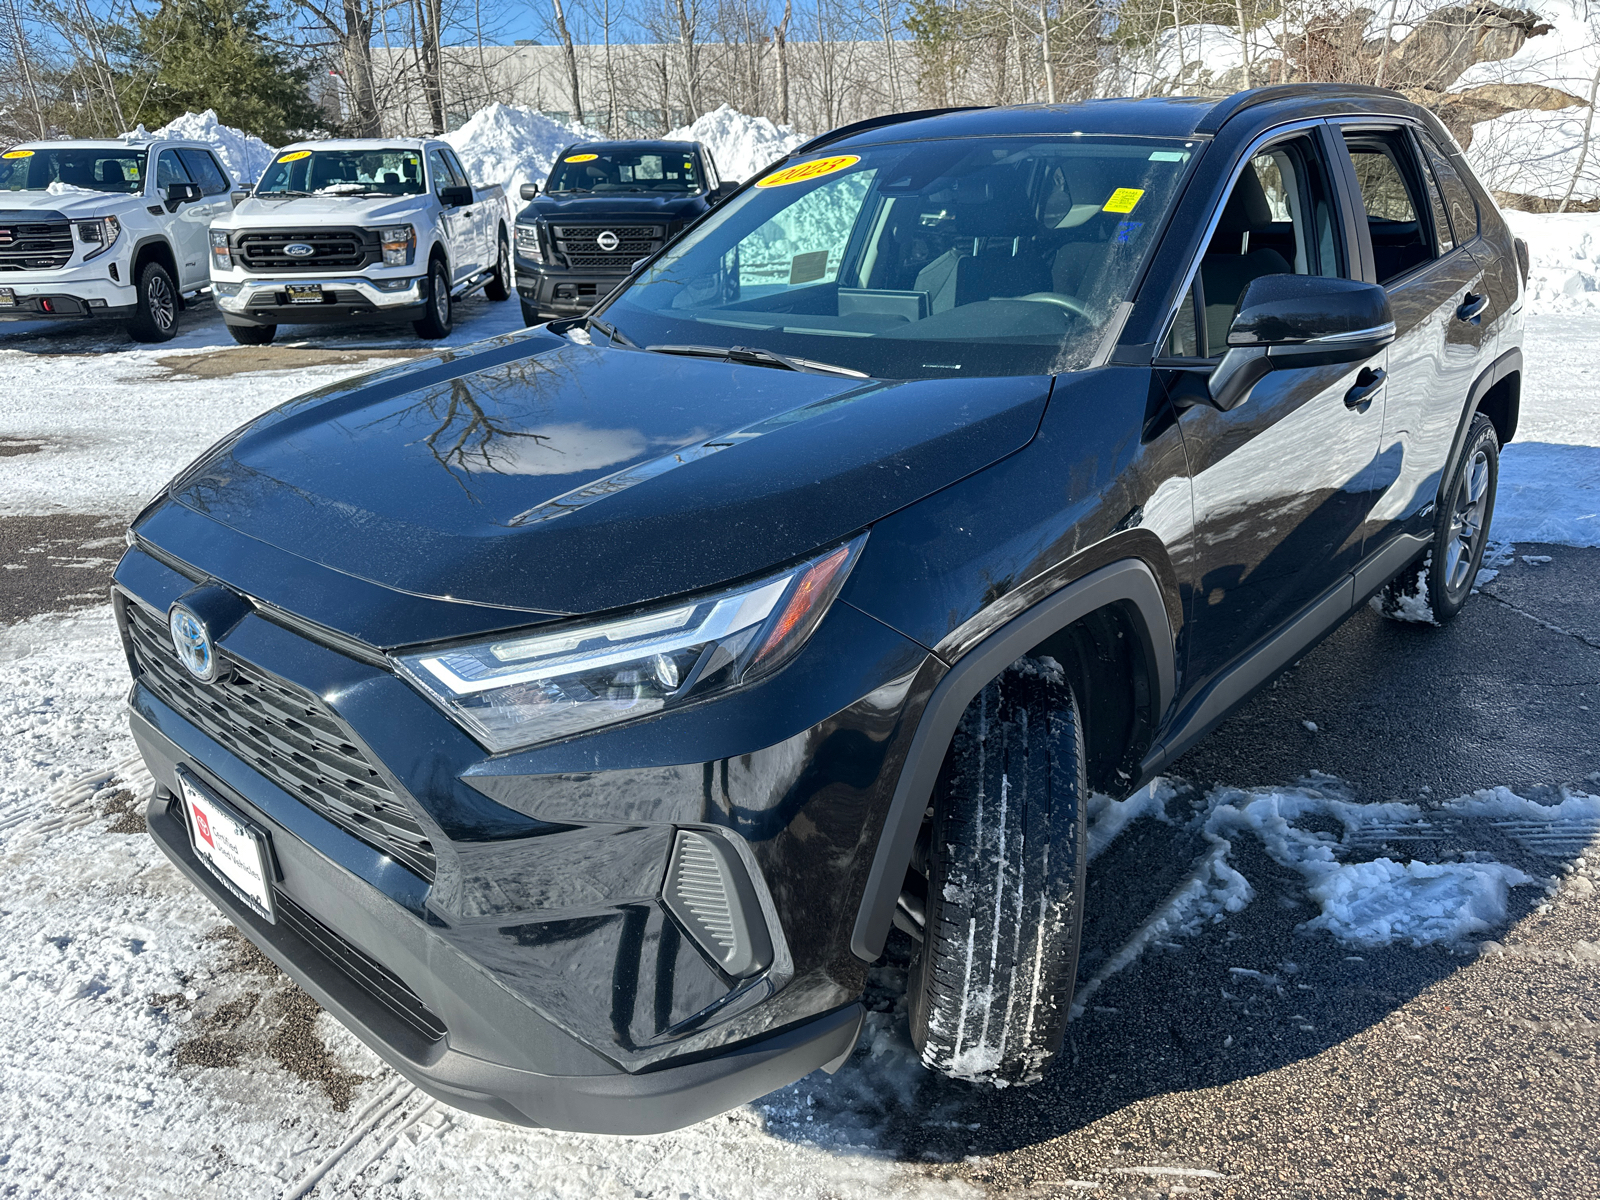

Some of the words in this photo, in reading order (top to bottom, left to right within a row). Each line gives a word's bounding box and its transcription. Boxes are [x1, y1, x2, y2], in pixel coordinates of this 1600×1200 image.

[766, 158, 847, 185] 2023
[212, 826, 239, 855] Certified
[216, 840, 231, 861] Used
[231, 853, 261, 881] Vehicles
